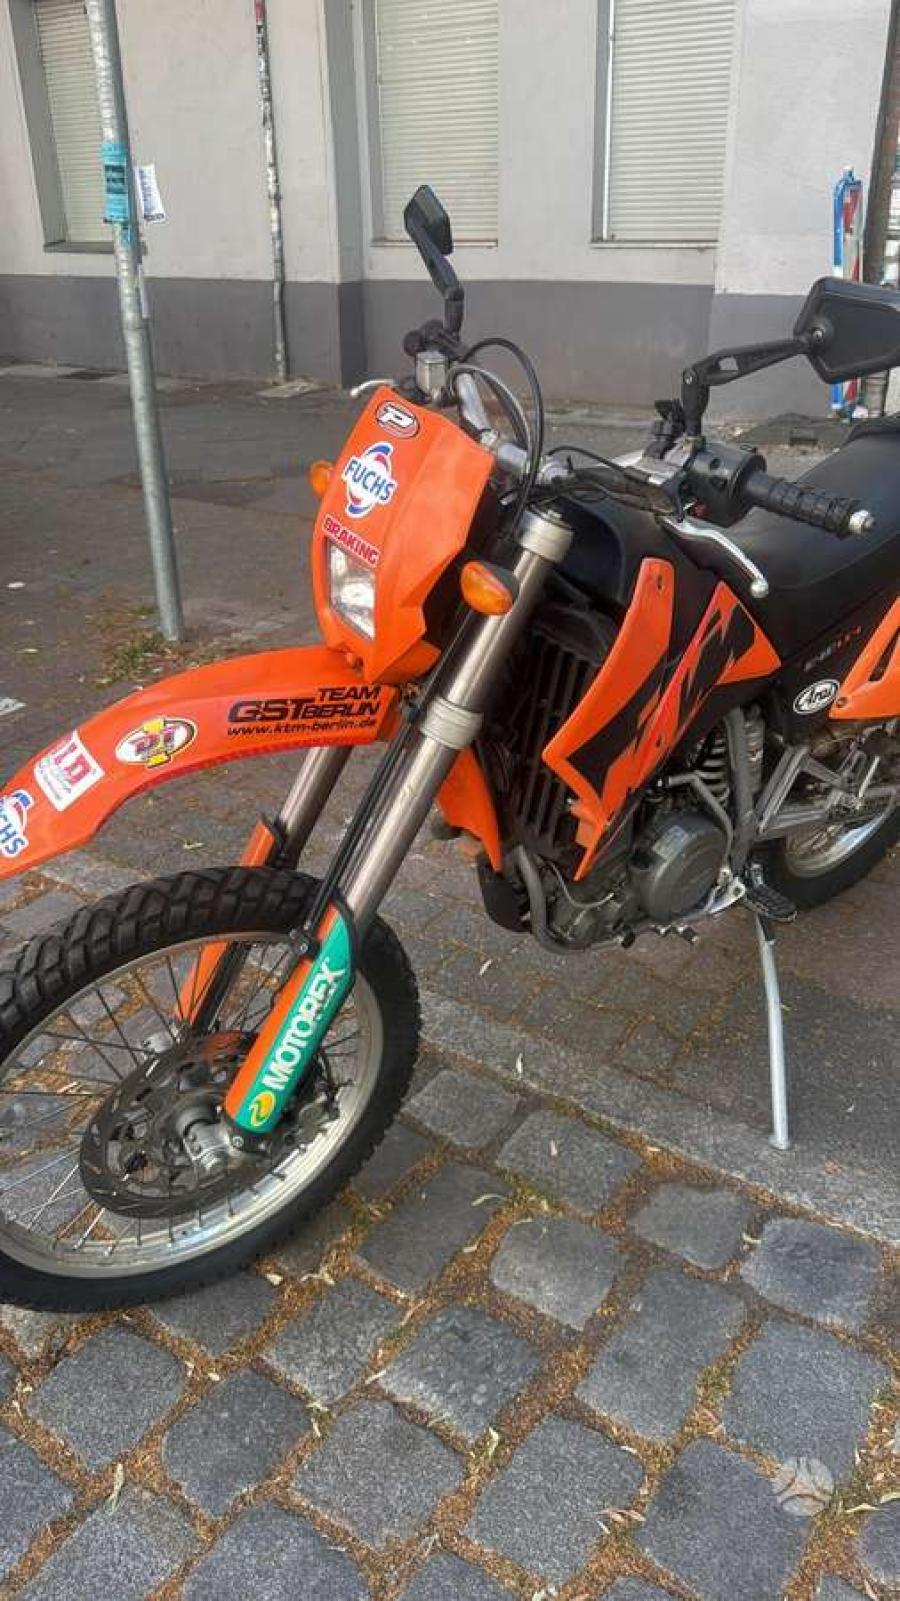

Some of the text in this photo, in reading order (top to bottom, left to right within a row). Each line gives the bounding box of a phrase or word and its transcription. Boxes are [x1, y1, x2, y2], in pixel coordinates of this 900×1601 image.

[344, 460, 395, 501] FUCHS
[324, 517, 378, 564] BRAKING
[318, 685, 381, 701] TEAM
[228, 697, 380, 723] GST BERLIN
[227, 718, 377, 736] www.ktm-berlin.de
[262, 958, 346, 1090] MOTOREX
